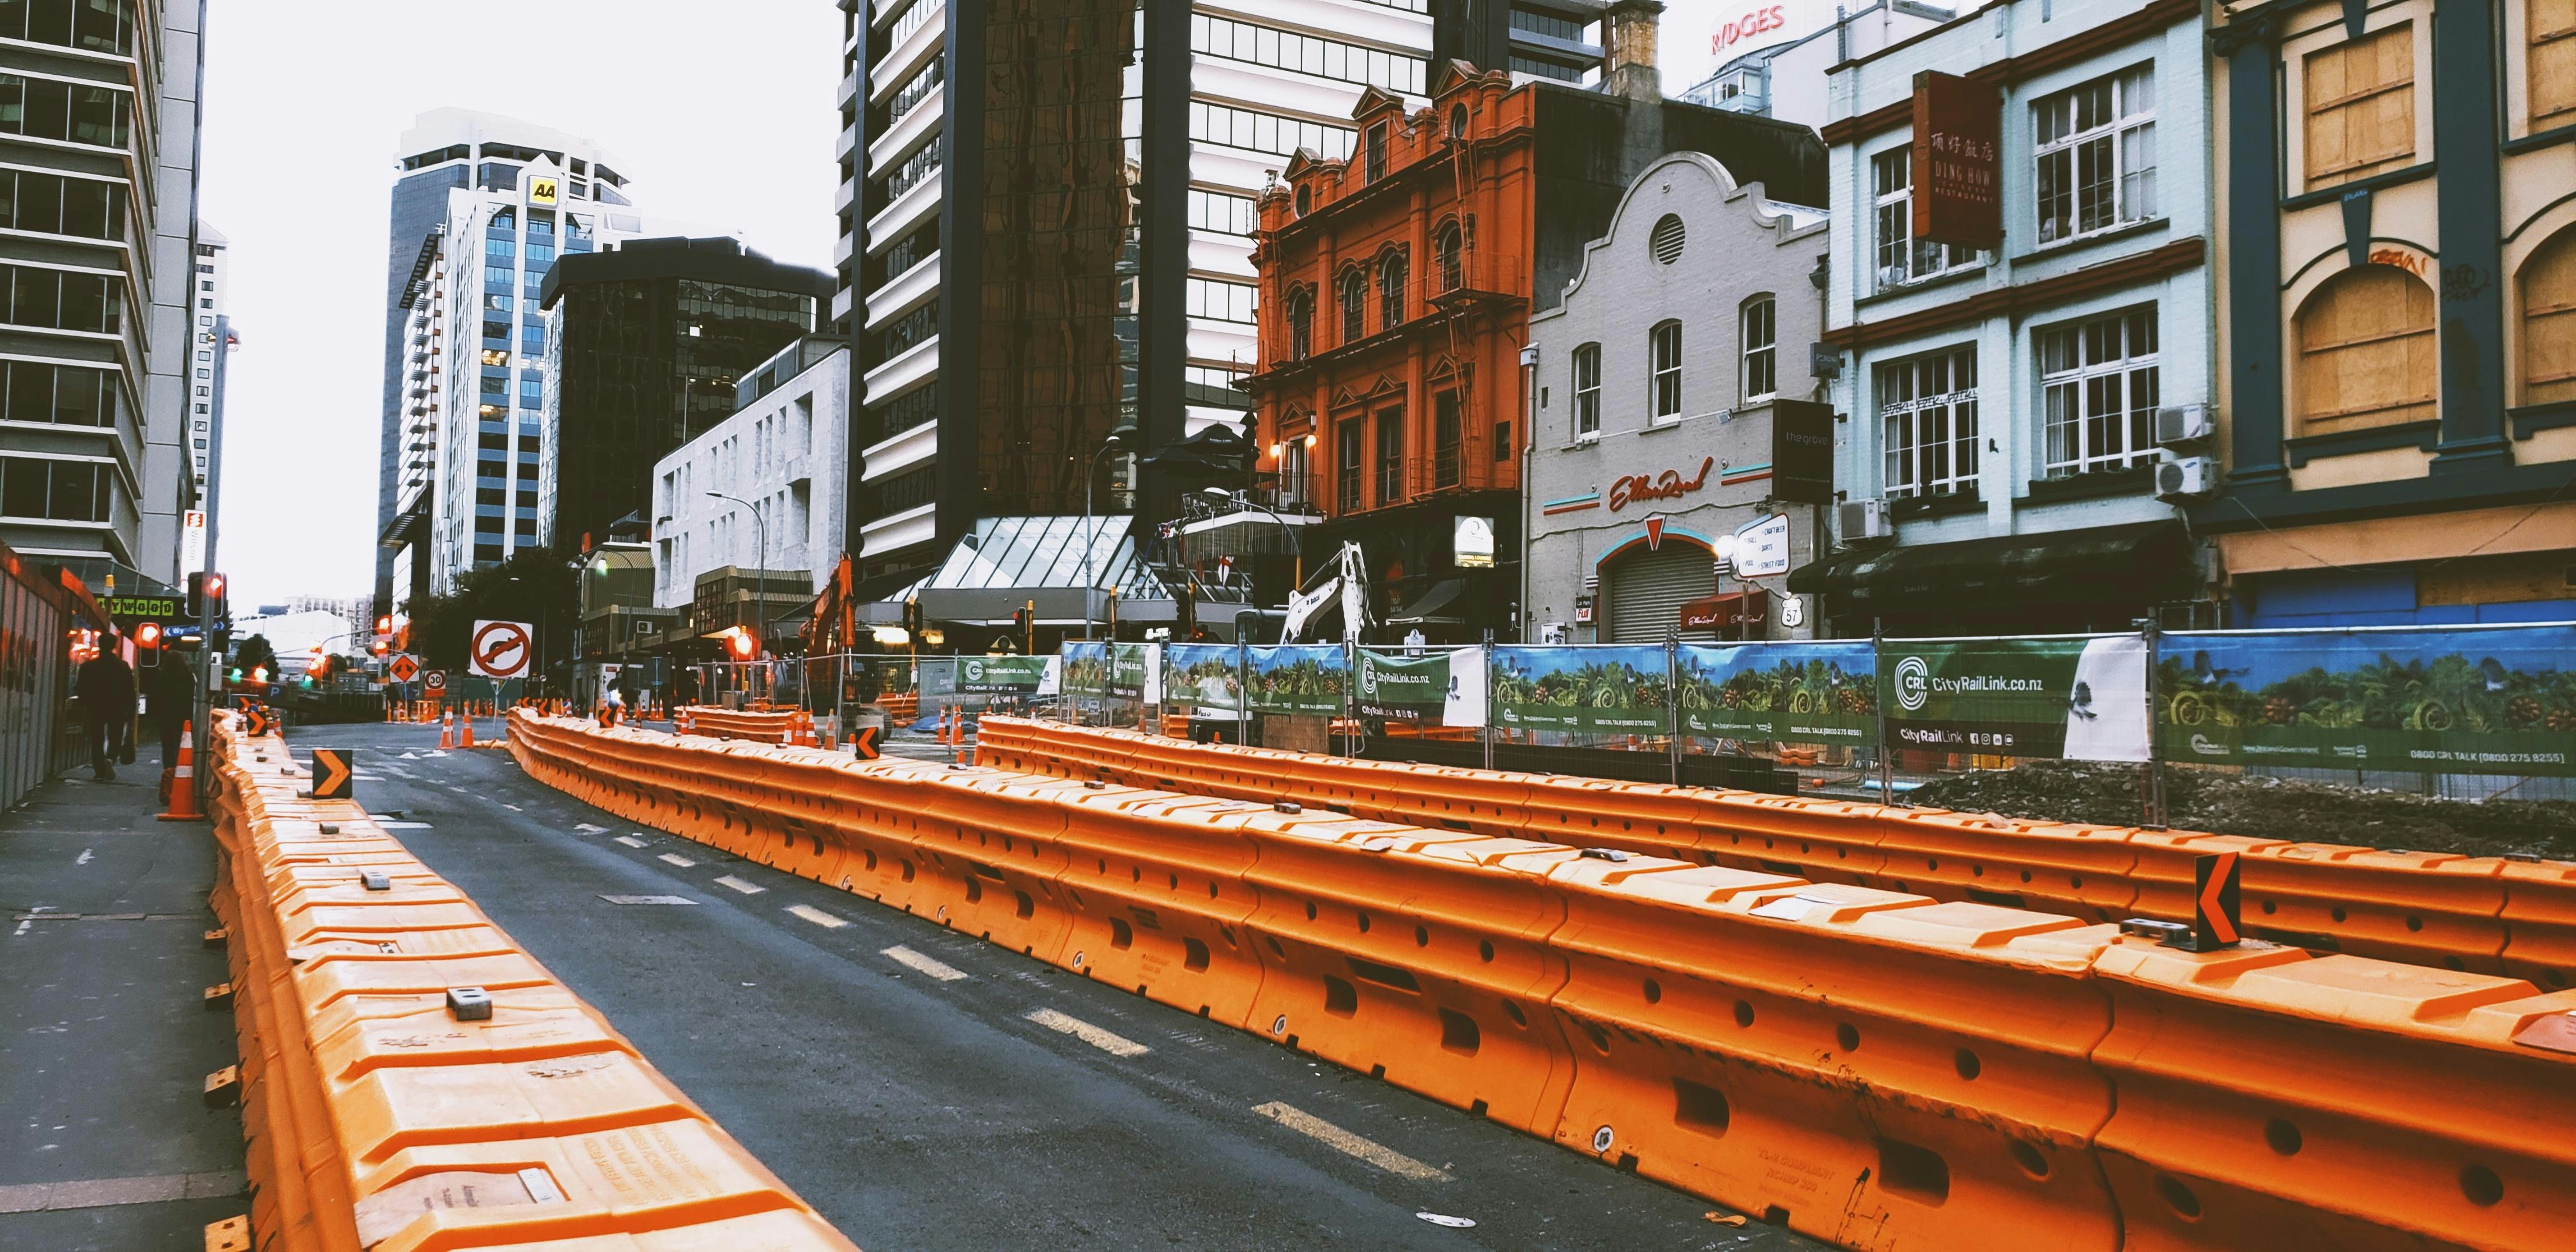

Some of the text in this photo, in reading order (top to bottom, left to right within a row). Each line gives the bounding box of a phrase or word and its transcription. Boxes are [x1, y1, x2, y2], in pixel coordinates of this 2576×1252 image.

[1935, 160, 1990, 186] DING HOW
[533, 183, 555, 198] AA
[1935, 187, 1993, 203] RESTAURANT
[1786, 431, 1828, 445] the grove
[1765, 527, 1775, 535] CRAFT
[189, 529, 198, 560] Wilson
[1761, 560, 1774, 569] STREET
[1578, 609, 1589, 618] Full
[1786, 610, 1797, 622] 57
[1367, 670, 1430, 684] CRL CityRailLink.co.nz
[270, 687, 280, 697] P
[1905, 676, 2044, 695] CRL CityRailLink.co.nz
[1900, 728, 1963, 744] CityRailLink
[2411, 750, 2435, 759] 0800
[2436, 751, 2453, 760] CRL
[2454, 752, 2478, 761] TALK
[2510, 753, 2531, 762] 275
